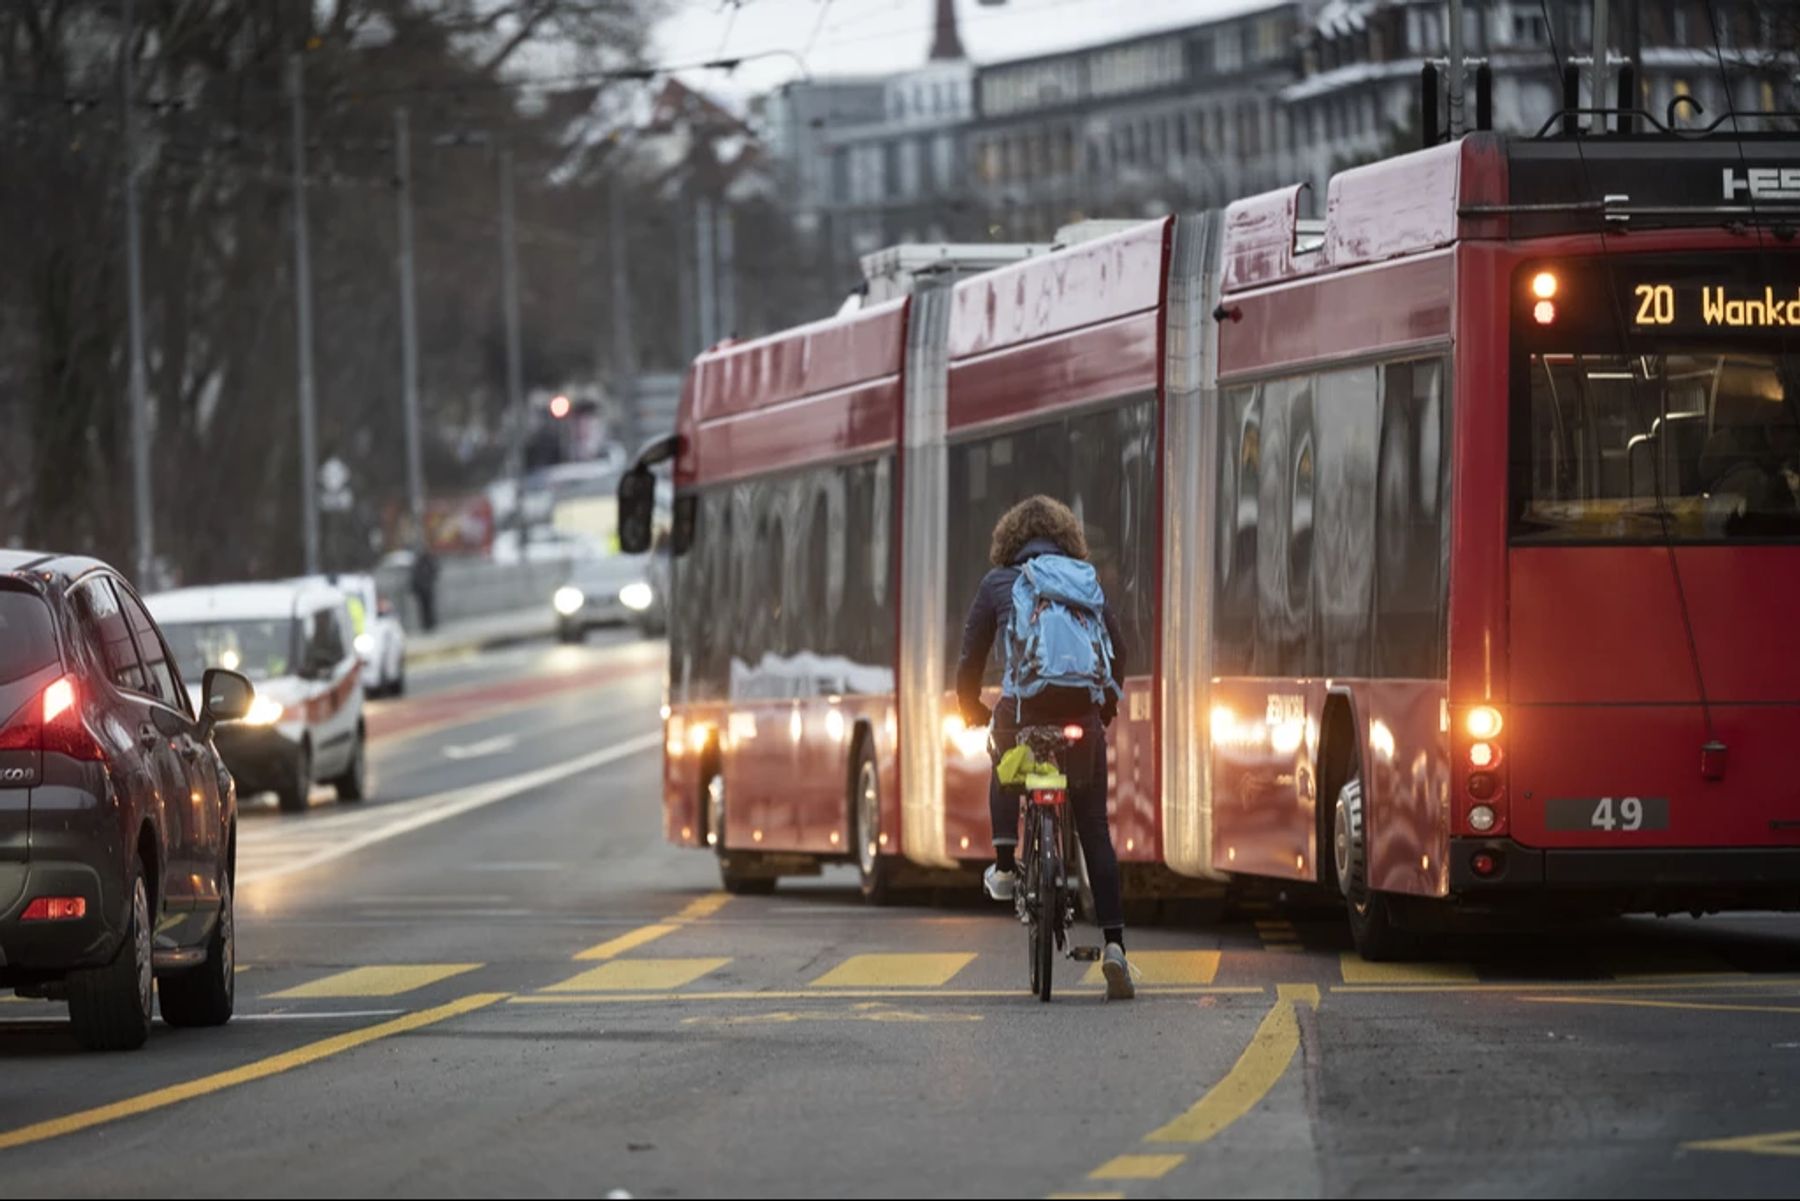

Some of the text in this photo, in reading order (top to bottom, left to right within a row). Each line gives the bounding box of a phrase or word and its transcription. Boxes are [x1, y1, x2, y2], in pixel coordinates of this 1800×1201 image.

[1635, 284, 1800, 325] 20 Wankd
[1591, 796, 1642, 831] 49
